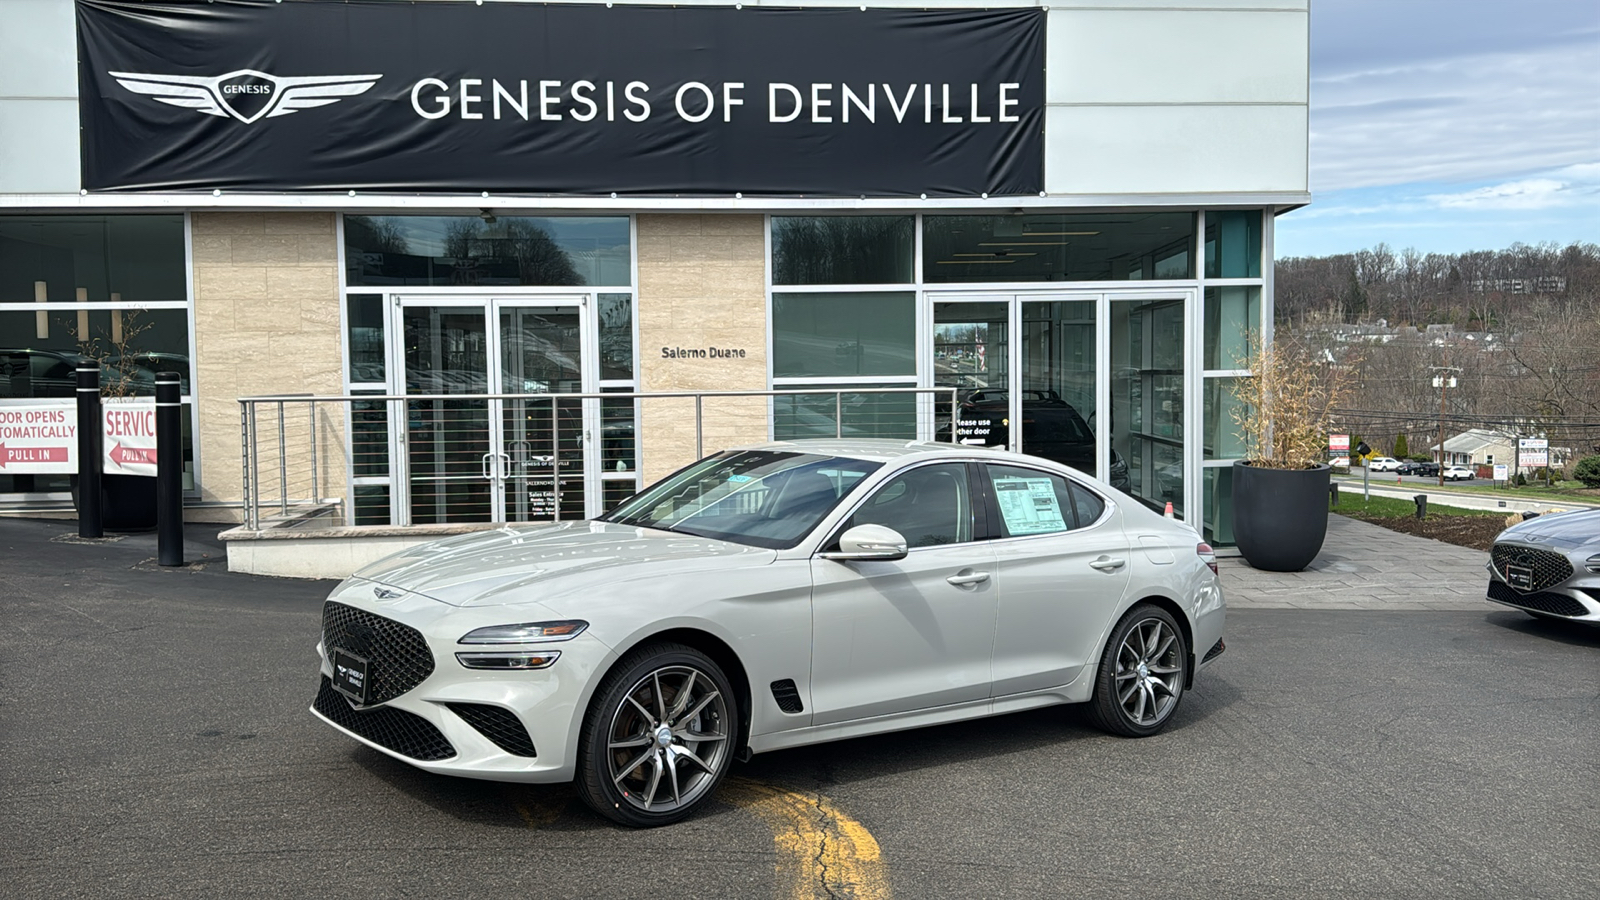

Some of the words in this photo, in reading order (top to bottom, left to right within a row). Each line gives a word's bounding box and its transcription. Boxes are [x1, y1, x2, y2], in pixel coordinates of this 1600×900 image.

[223, 84, 271, 94] GENESIS
[411, 77, 651, 122] GENESIS
[674, 81, 745, 122] OF
[768, 82, 1020, 125] DENVILLE
[661, 346, 706, 359] Salerno
[709, 347, 746, 359] Duane
[25, 410, 65, 424] OPENS
[106, 410, 157, 437] SERVIC
[956, 427, 973, 435] ther
[973, 427, 990, 435] door
[8, 449, 34, 460] PULL
[39, 449, 50, 460] IN
[121, 449, 139, 461] PULL
